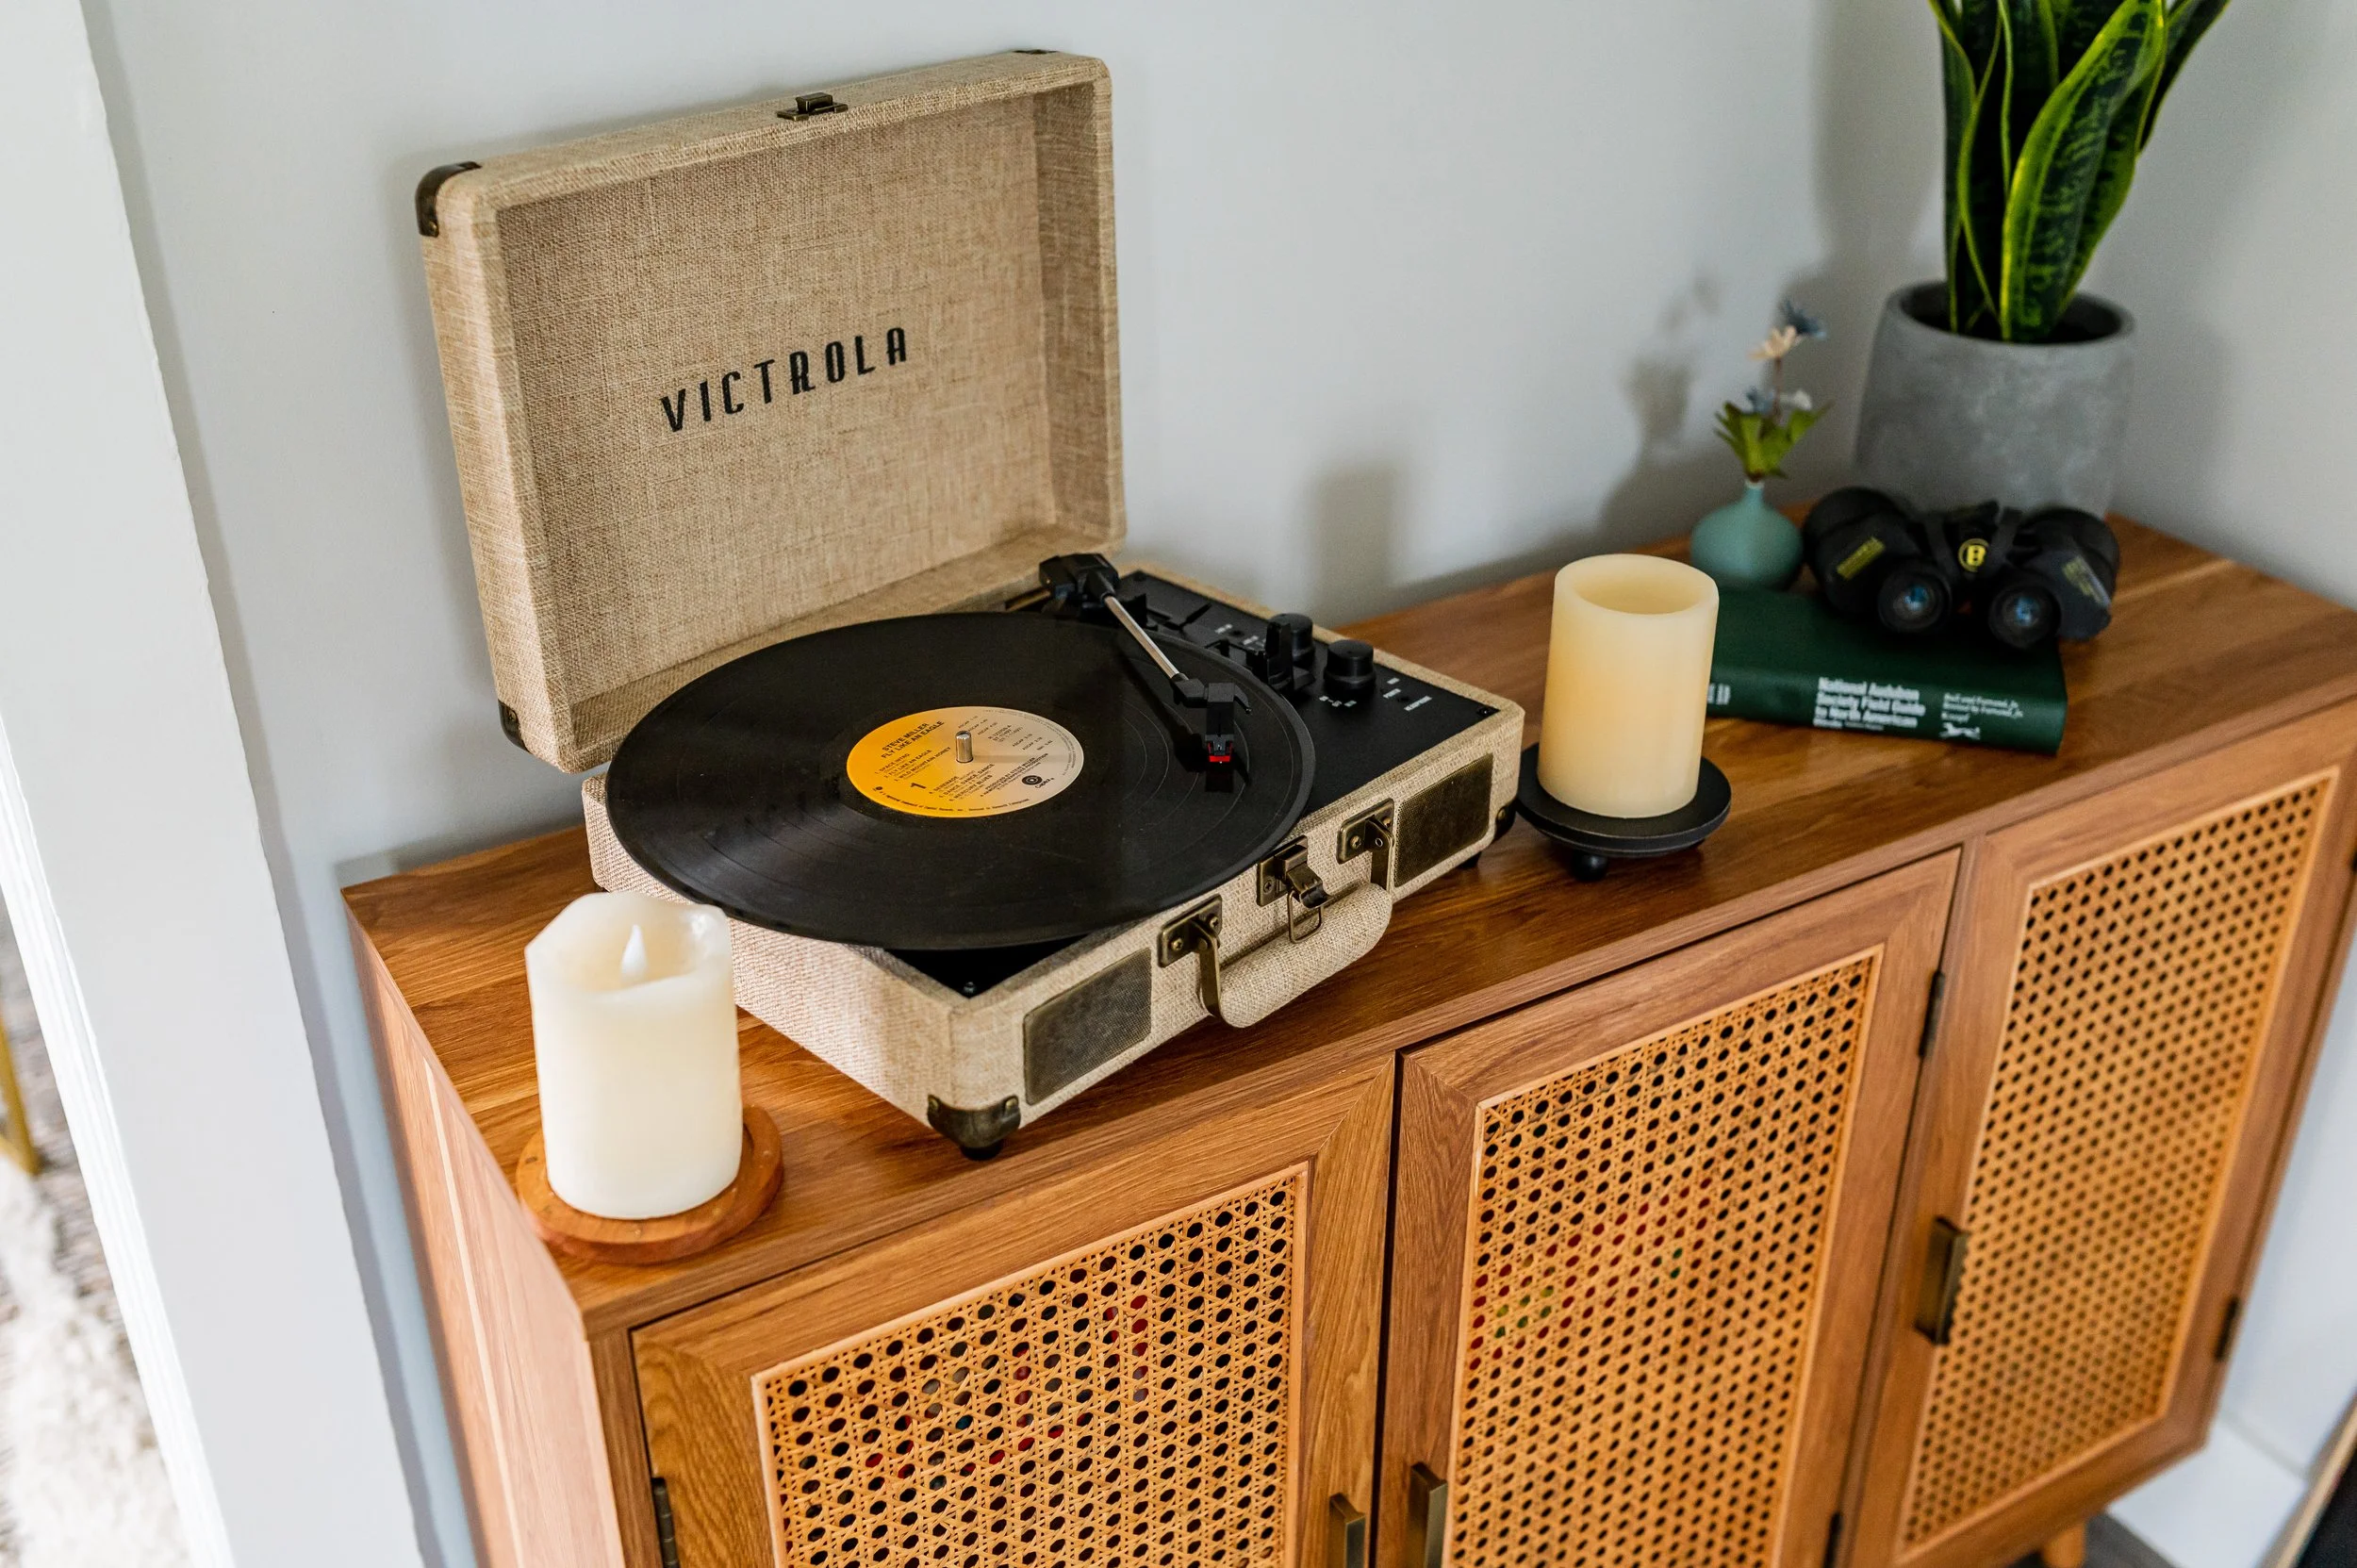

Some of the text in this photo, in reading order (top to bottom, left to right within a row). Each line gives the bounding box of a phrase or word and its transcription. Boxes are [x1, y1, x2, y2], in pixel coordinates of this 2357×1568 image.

[660, 327, 906, 432] VICTROLA
[1967, 545, 1986, 565] B
[882, 724, 929, 751] STEVE MILLER
[882, 750, 895, 758] FLY
[895, 741, 912, 751] LIKE
[920, 721, 944, 734] EAGLE
